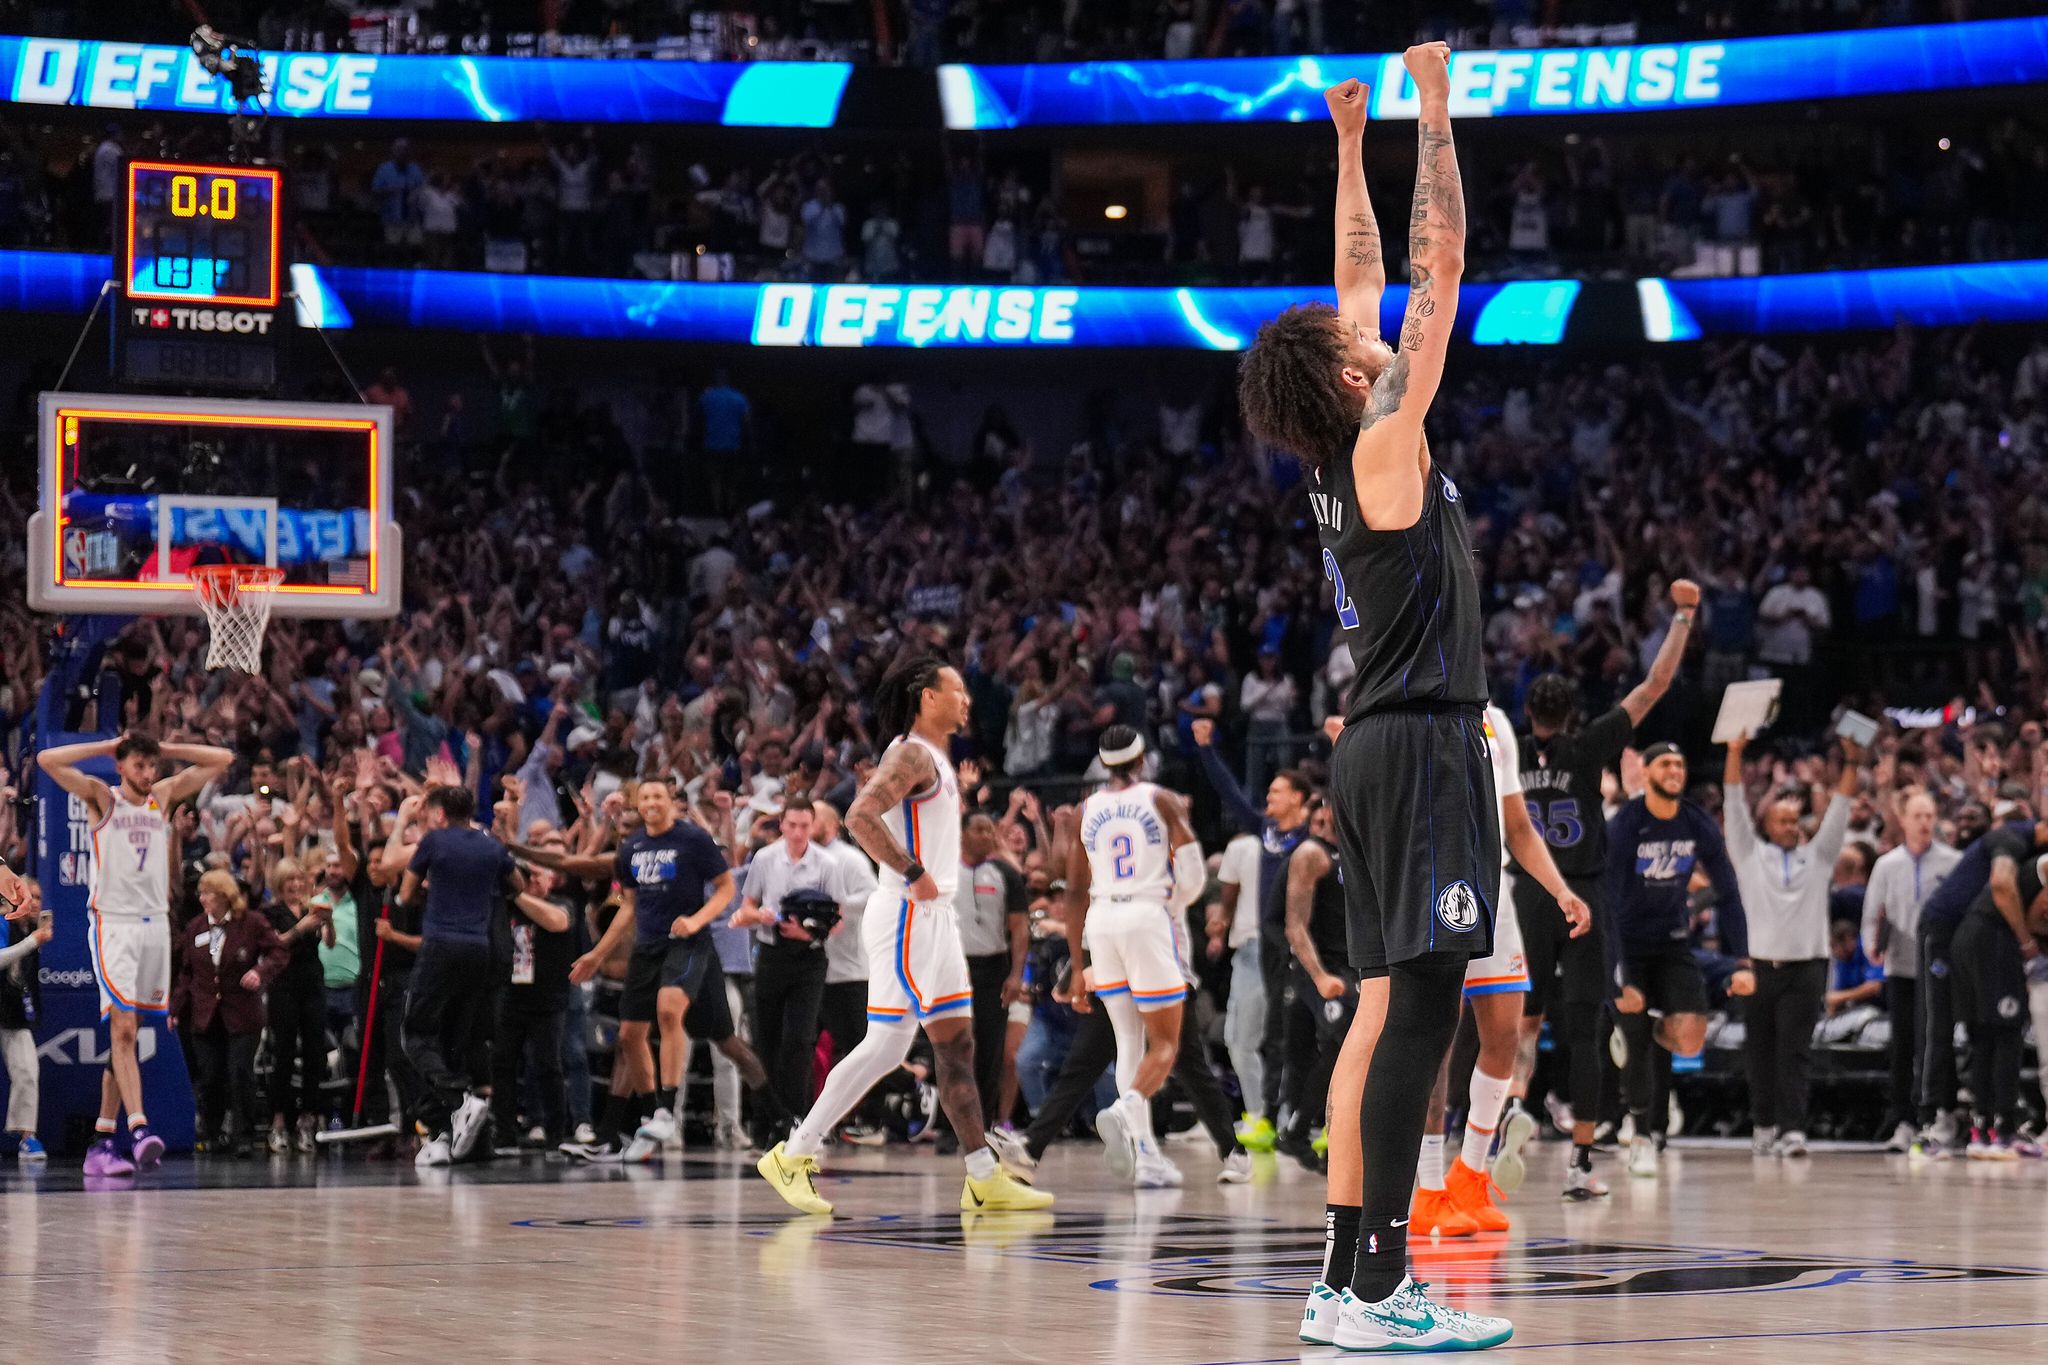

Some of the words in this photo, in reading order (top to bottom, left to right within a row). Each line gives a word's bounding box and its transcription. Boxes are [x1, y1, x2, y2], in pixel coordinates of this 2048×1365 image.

[171, 176, 236, 220] 0.0
[171, 308, 274, 335] TISSOT
[752, 284, 1079, 347] DEFENSE
[1322, 547, 1360, 630] 2
[1519, 770, 1551, 792] ONES
[135, 847, 149, 872] 7
[1111, 832, 1136, 880] 2
[38, 967, 93, 988] Google
